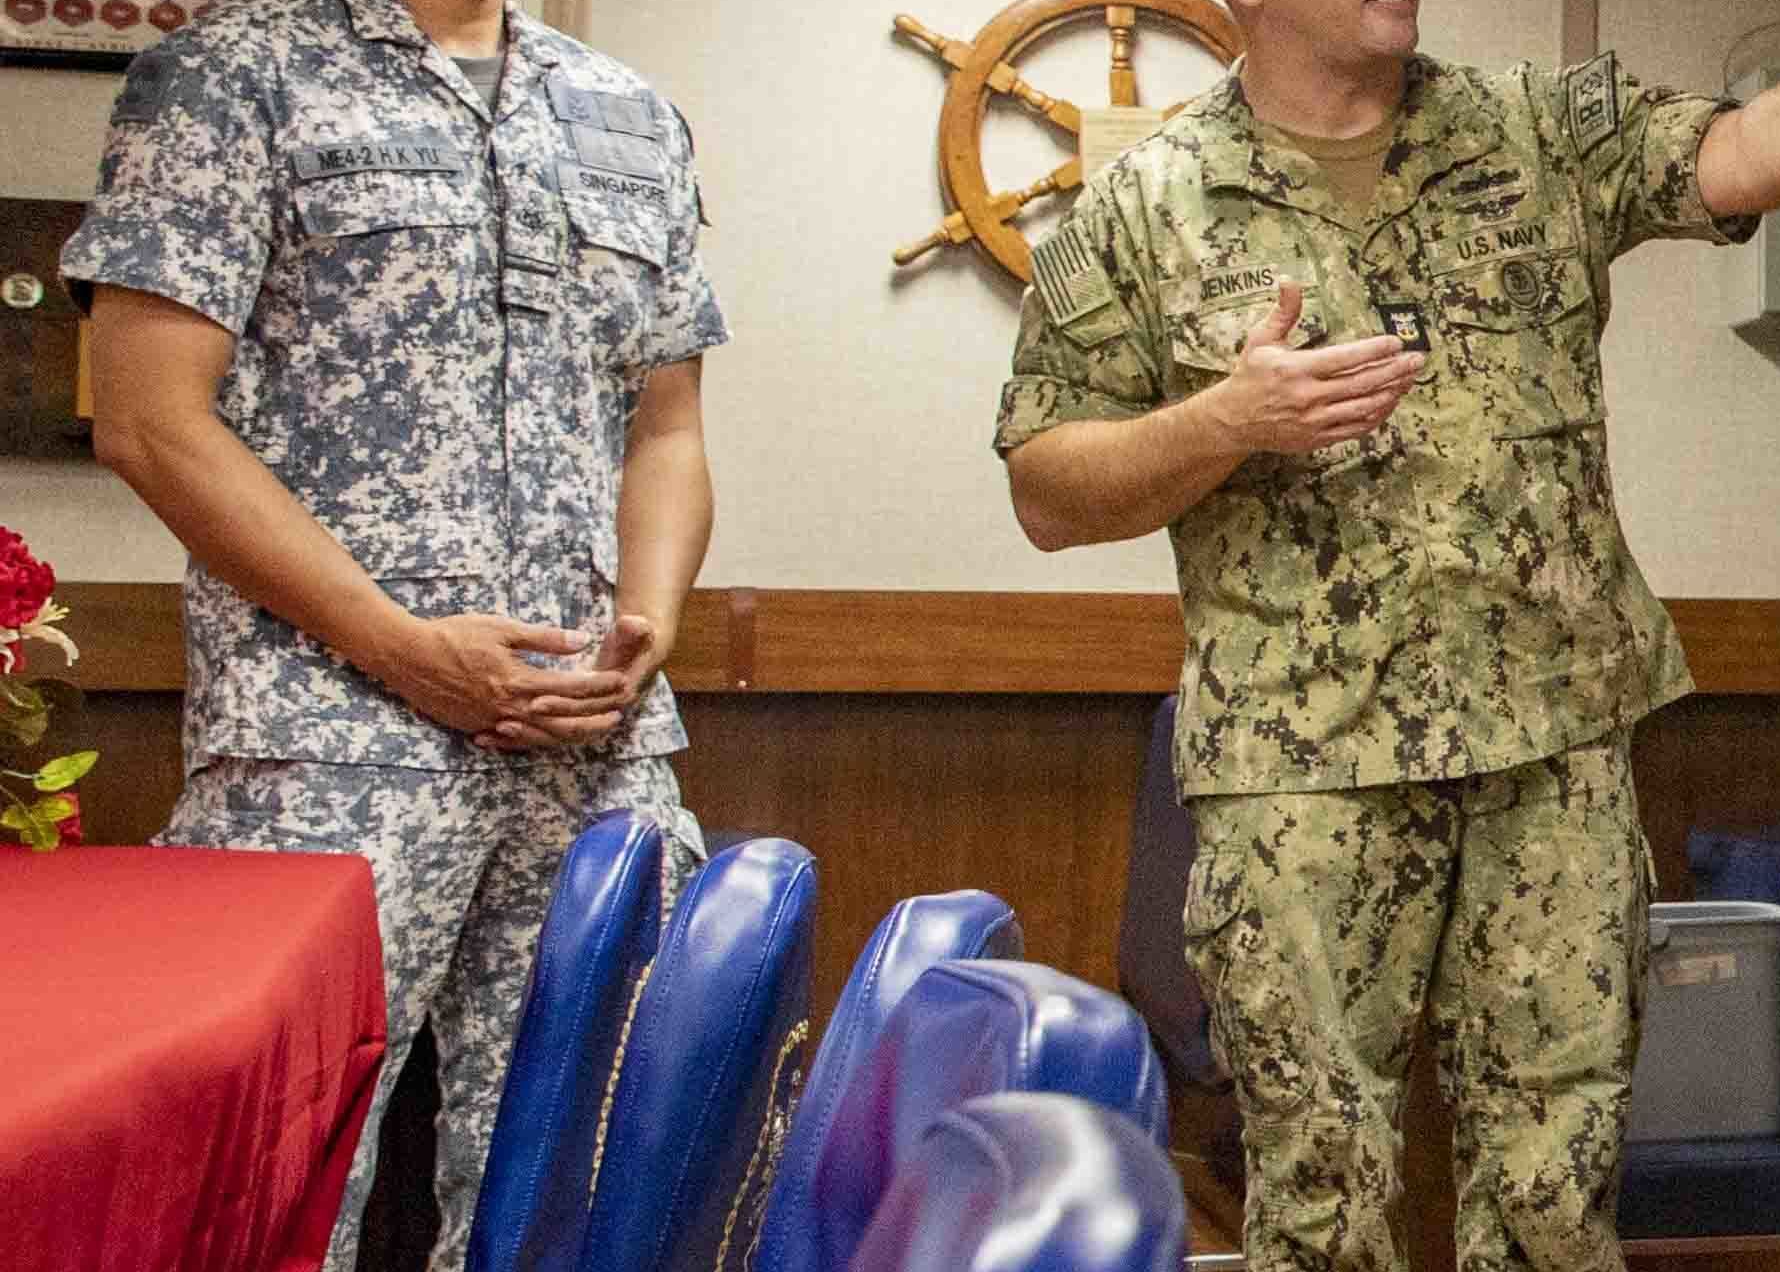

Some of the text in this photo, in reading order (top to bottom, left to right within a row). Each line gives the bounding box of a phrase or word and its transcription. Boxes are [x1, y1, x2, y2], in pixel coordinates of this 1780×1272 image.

[316, 146, 375, 170] ME4-2
[579, 171, 667, 205] SINGAPORE
[1457, 222, 1546, 260] U.S. NAVY
[1199, 268, 1275, 299] JENKINS
